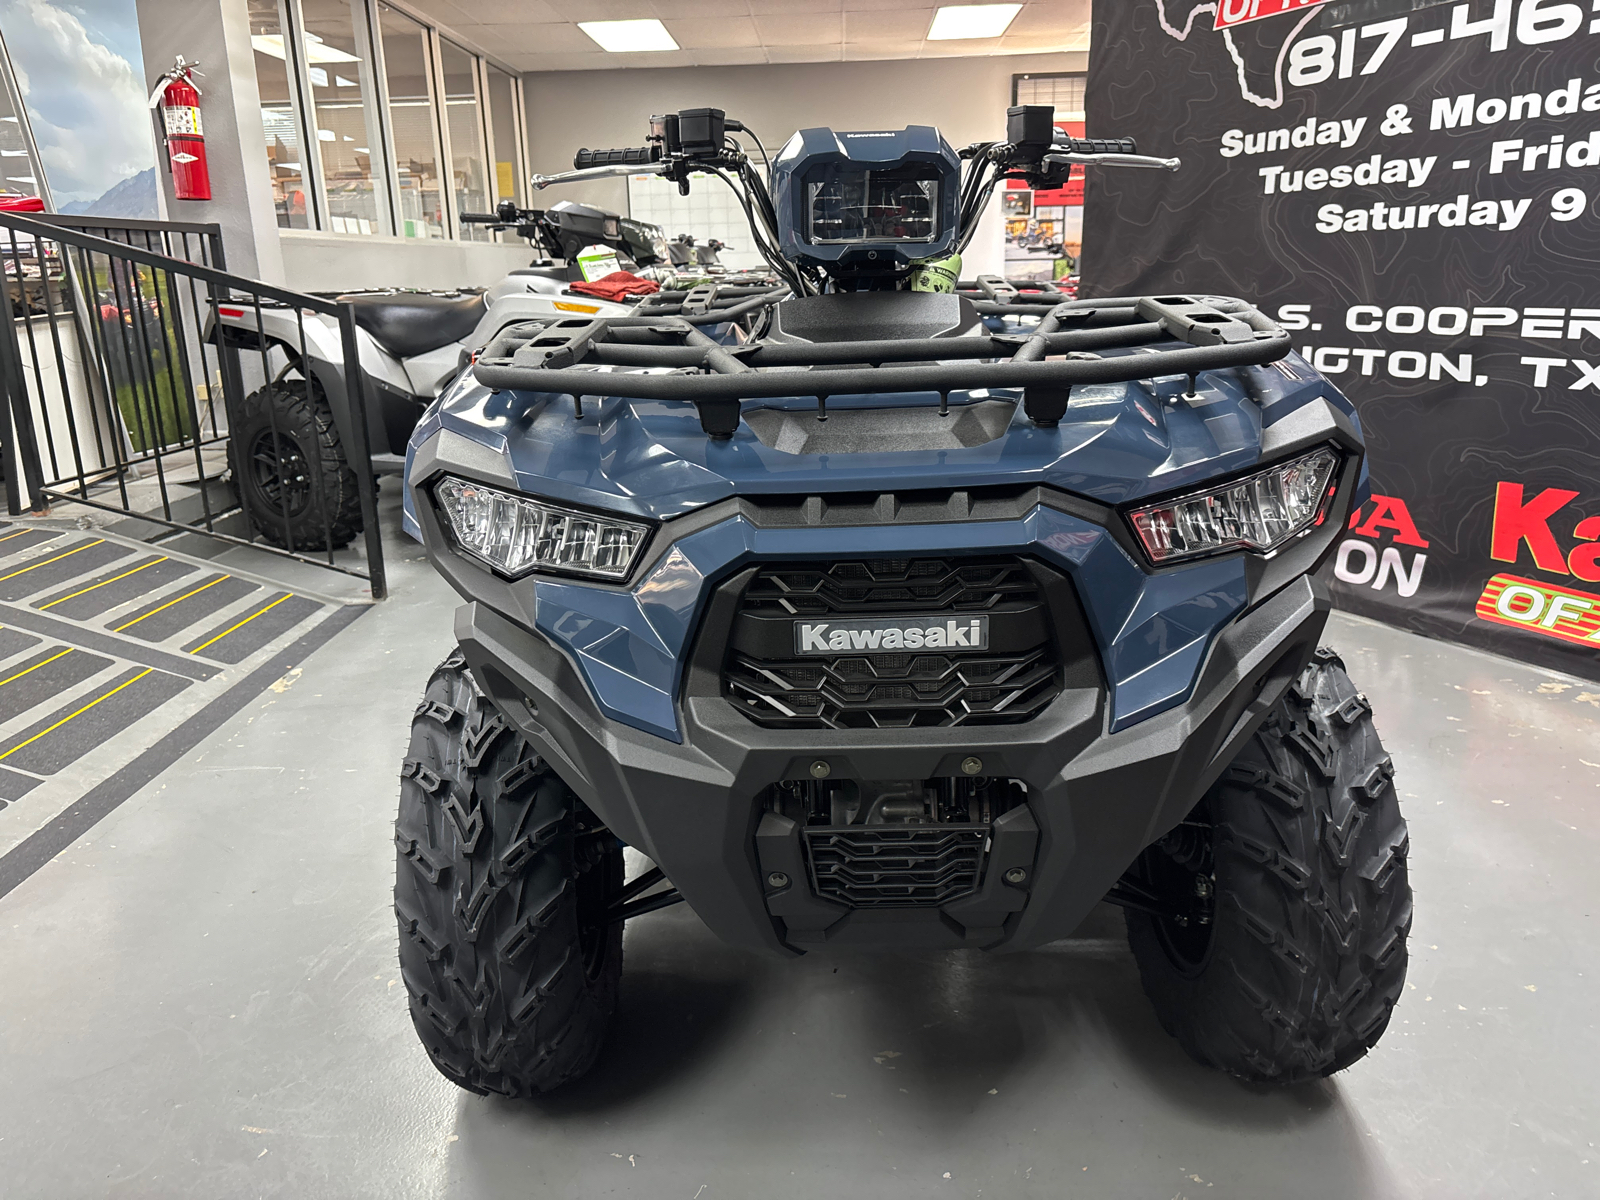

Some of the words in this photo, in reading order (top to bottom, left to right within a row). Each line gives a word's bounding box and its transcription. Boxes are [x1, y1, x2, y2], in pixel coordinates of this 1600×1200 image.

[1287, 0, 1600, 87] 817-46
[1219, 116, 1368, 158] Sunday
[1379, 103, 1414, 137] &
[1258, 155, 1438, 195] Tuesday
[1488, 130, 1600, 175] Frid
[1315, 194, 1533, 234] Saturday
[1550, 187, 1587, 222] 9
[1277, 304, 1322, 331] S.
[1345, 305, 1600, 340] COOPER
[1520, 356, 1600, 391] TX
[1497, 585, 1593, 628] OF
[802, 619, 980, 651] Kawasaki
